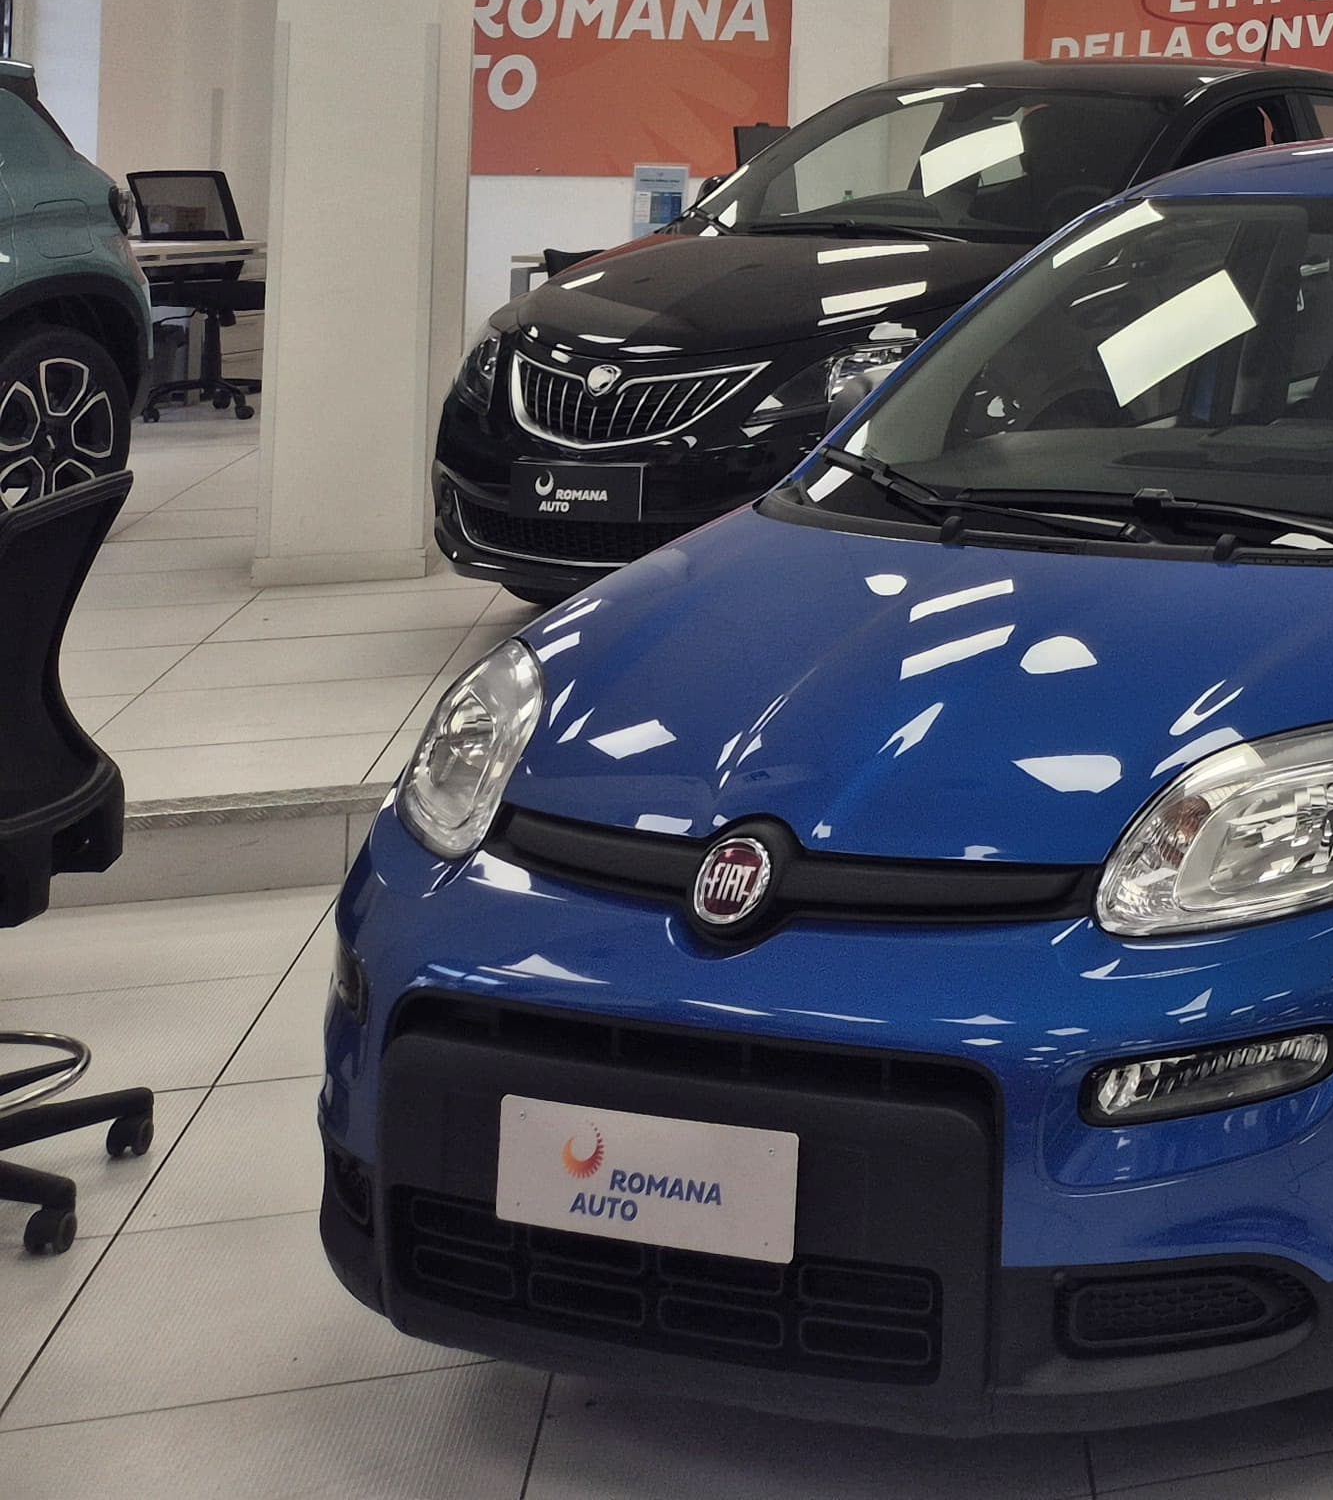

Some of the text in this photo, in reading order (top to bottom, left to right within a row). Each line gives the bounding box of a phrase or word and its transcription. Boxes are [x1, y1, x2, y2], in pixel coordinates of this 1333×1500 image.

[1050, 26, 1193, 59] DELLA
[538, 500, 570, 514] AUTO
[555, 488, 608, 503] ROMANA
[705, 861, 758, 903] FIAT
[608, 1168, 722, 1207] ROMANA
[569, 1192, 639, 1223] AUTO
